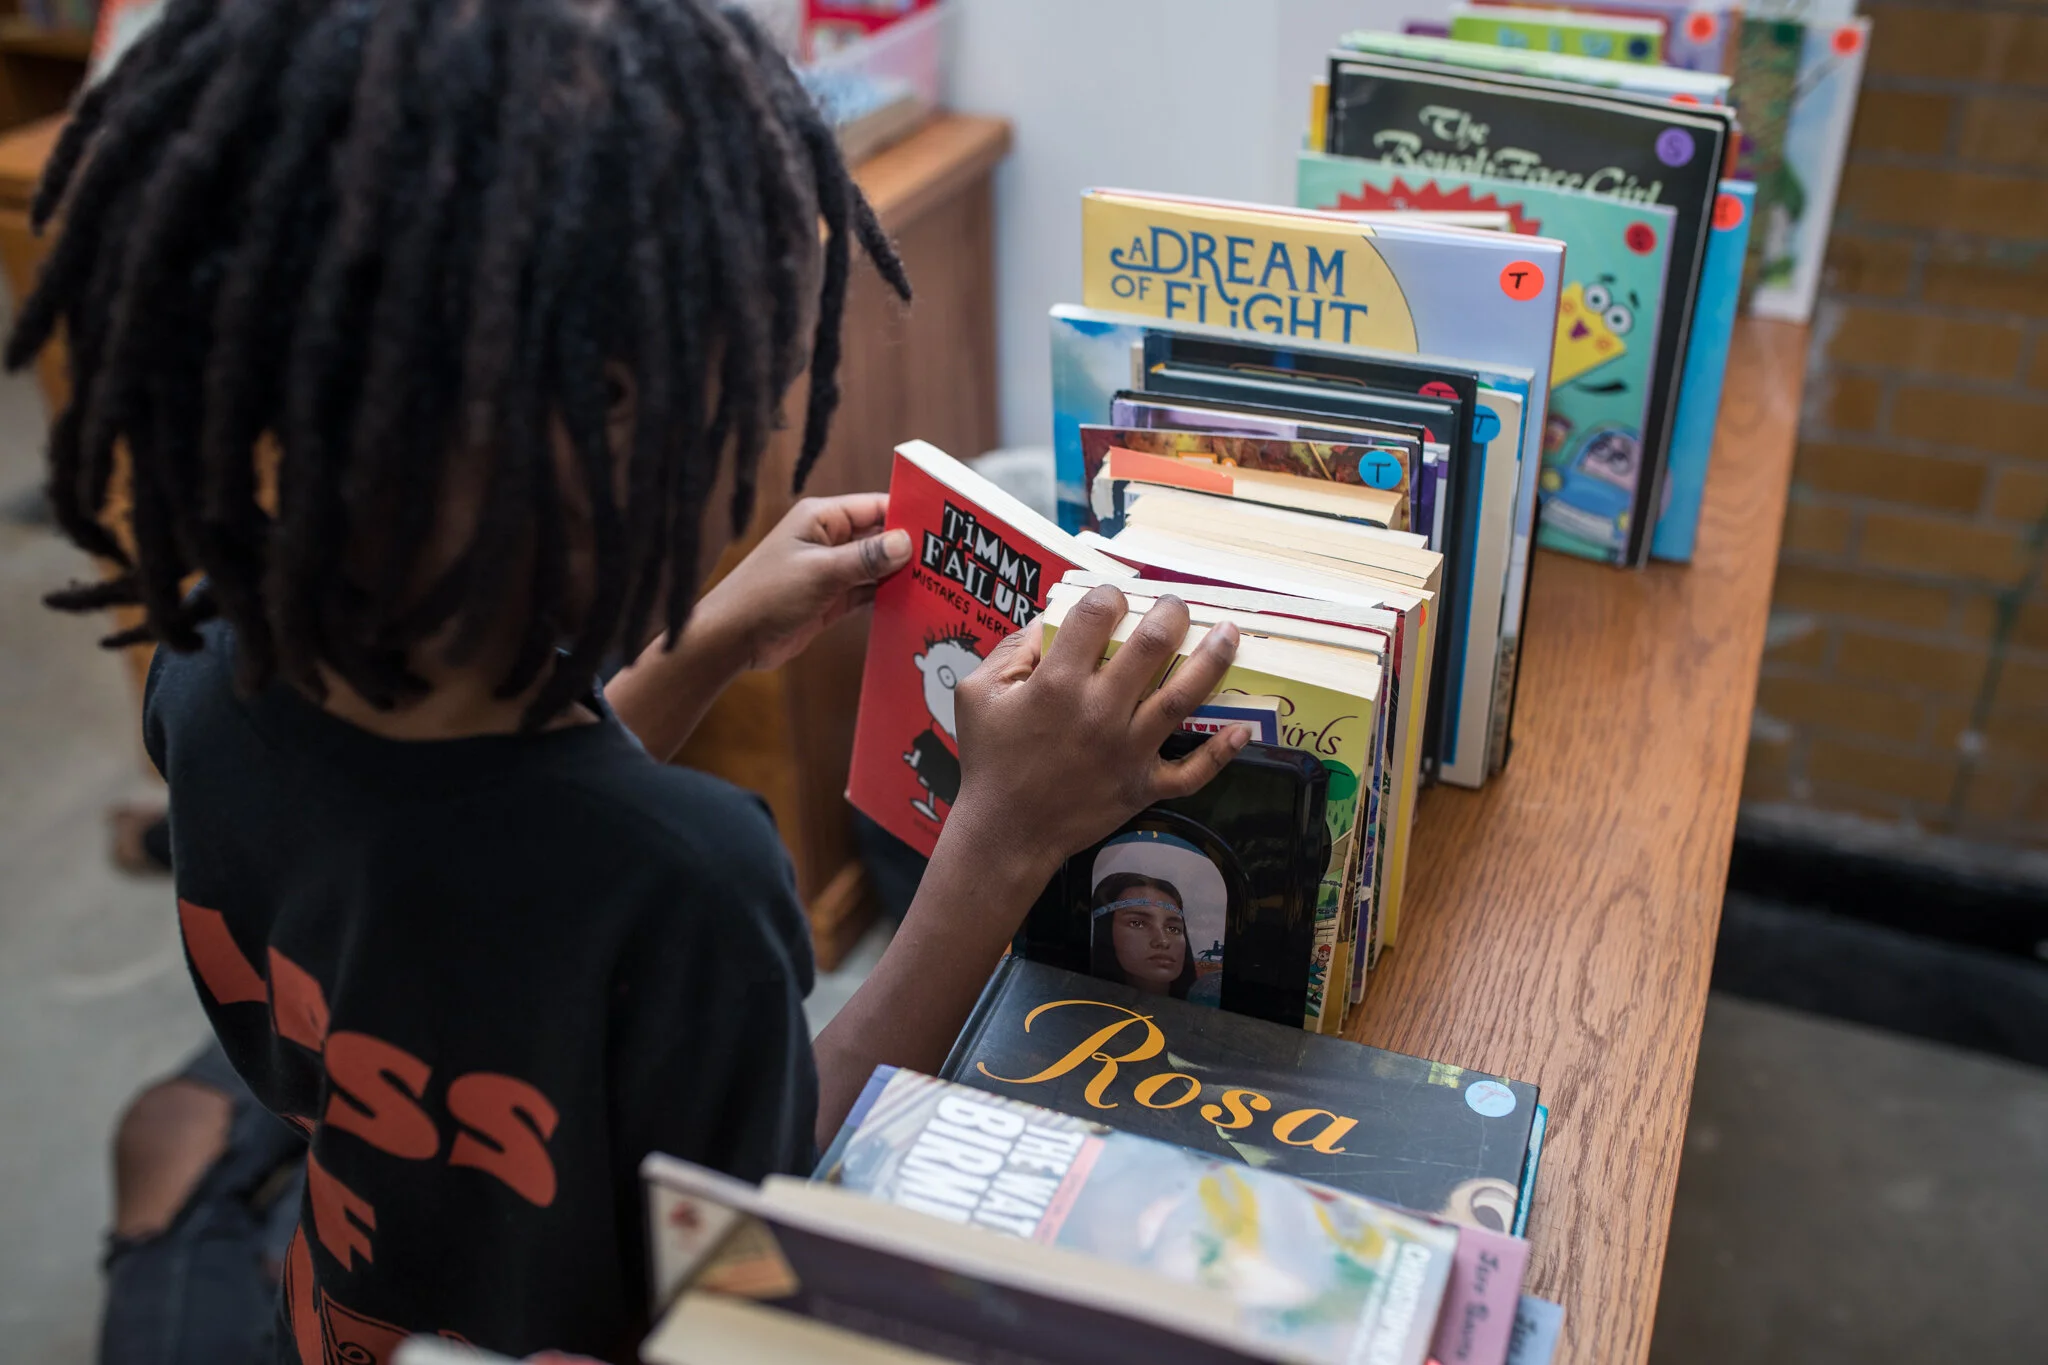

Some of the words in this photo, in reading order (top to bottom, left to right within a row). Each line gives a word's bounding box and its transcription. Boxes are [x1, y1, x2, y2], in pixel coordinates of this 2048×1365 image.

[1418, 105, 1490, 150] The
[1111, 226, 1346, 302] DREAM
[1111, 274, 1153, 300] OF
[1508, 272, 1528, 290] T
[1474, 412, 1497, 434] T
[1367, 462, 1391, 484] T
[911, 567, 971, 614] MISTAKES
[923, 532, 1040, 628] FAILUR
[1272, 694, 1359, 755] irls
[977, 1000, 1359, 1155] Rosa
[1007, 1124, 1085, 1176] THE
